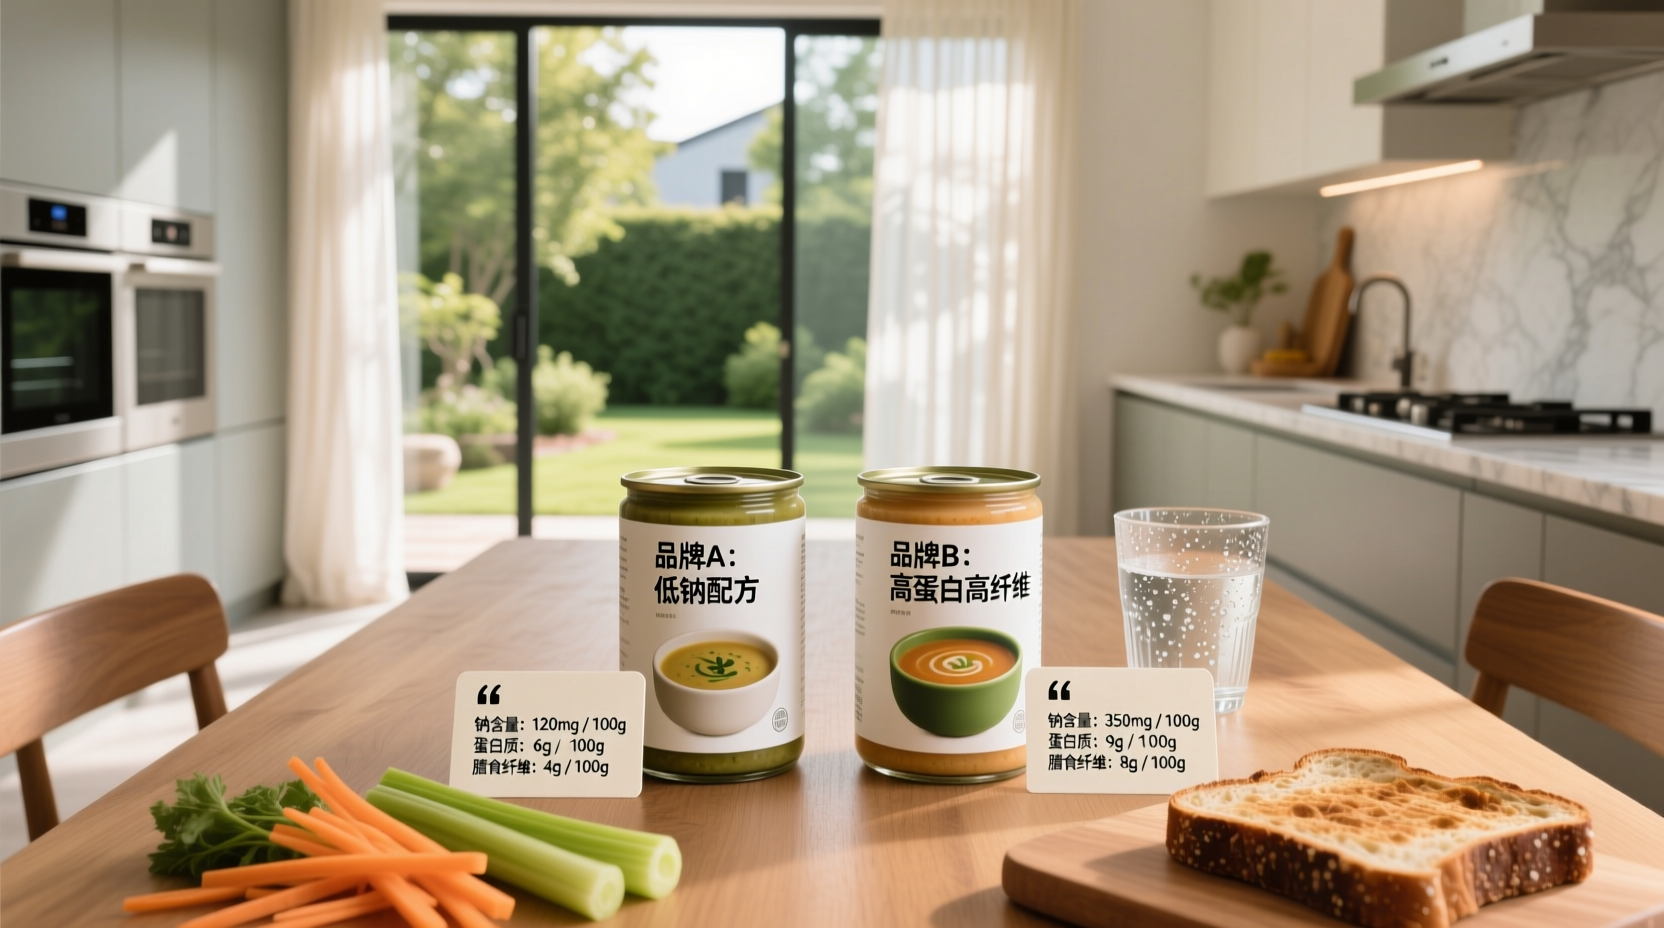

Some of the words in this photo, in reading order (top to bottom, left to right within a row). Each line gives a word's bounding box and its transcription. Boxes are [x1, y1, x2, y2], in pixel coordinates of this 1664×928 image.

[655, 541, 736, 570] 品牌A：
[890, 540, 970, 569] 品牌B：
[653, 575, 760, 605] 低钠配方
[889, 570, 1031, 604] 高蛋白高纤维
